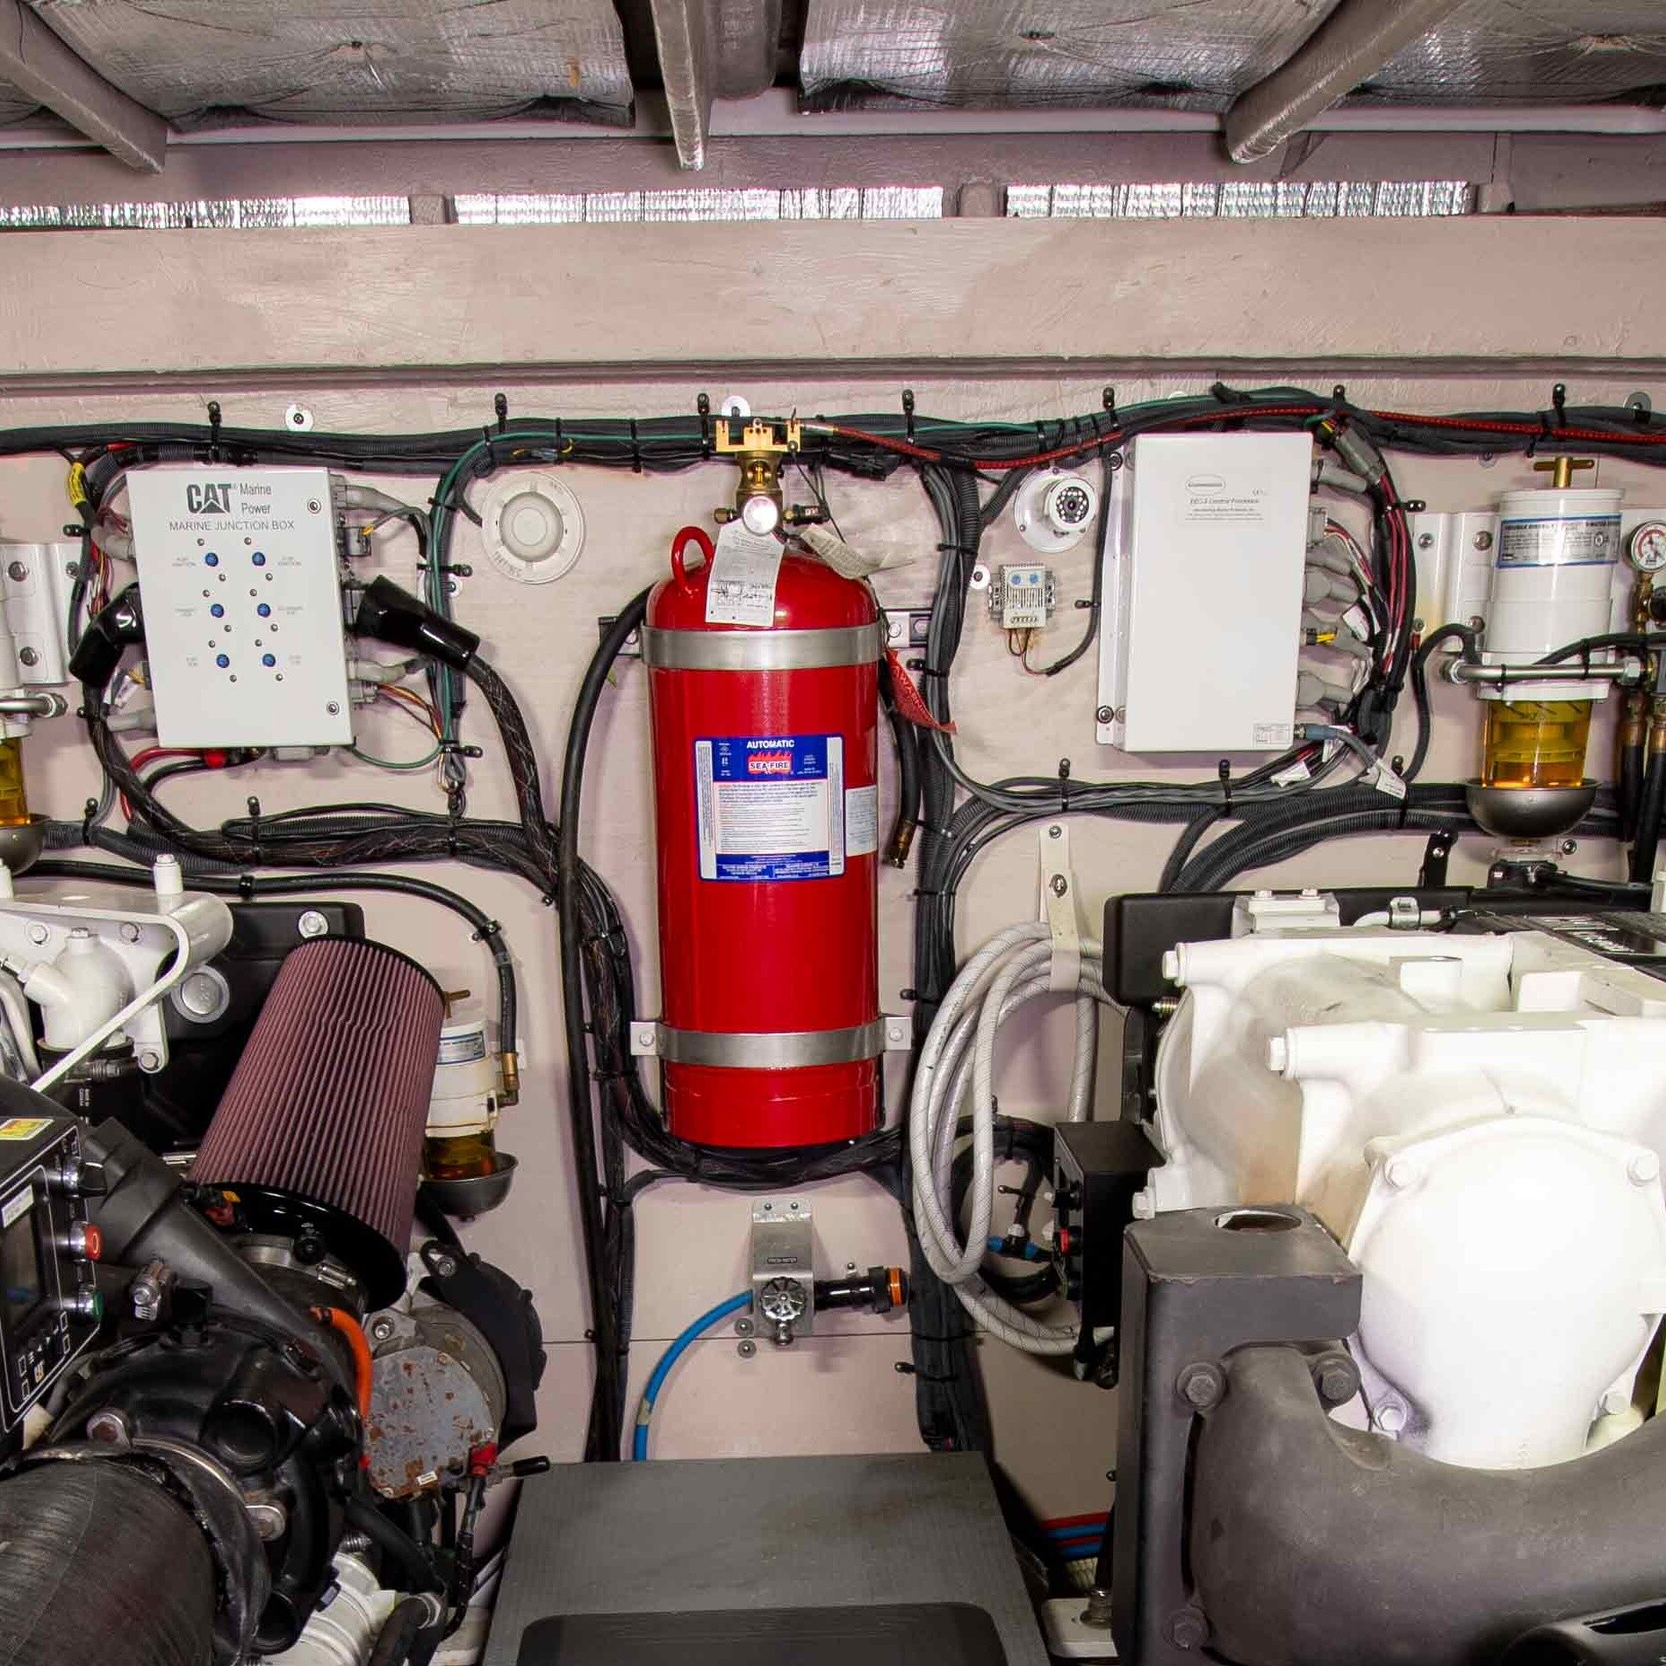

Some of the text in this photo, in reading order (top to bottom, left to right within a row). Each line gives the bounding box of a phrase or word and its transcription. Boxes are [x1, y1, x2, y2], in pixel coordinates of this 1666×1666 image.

[186, 483, 272, 514] CAT Marine
[241, 502, 271, 515] Power
[169, 520, 295, 531] MARINE JUNCTION BOX
[746, 739, 795, 749] AUTOMATIC
